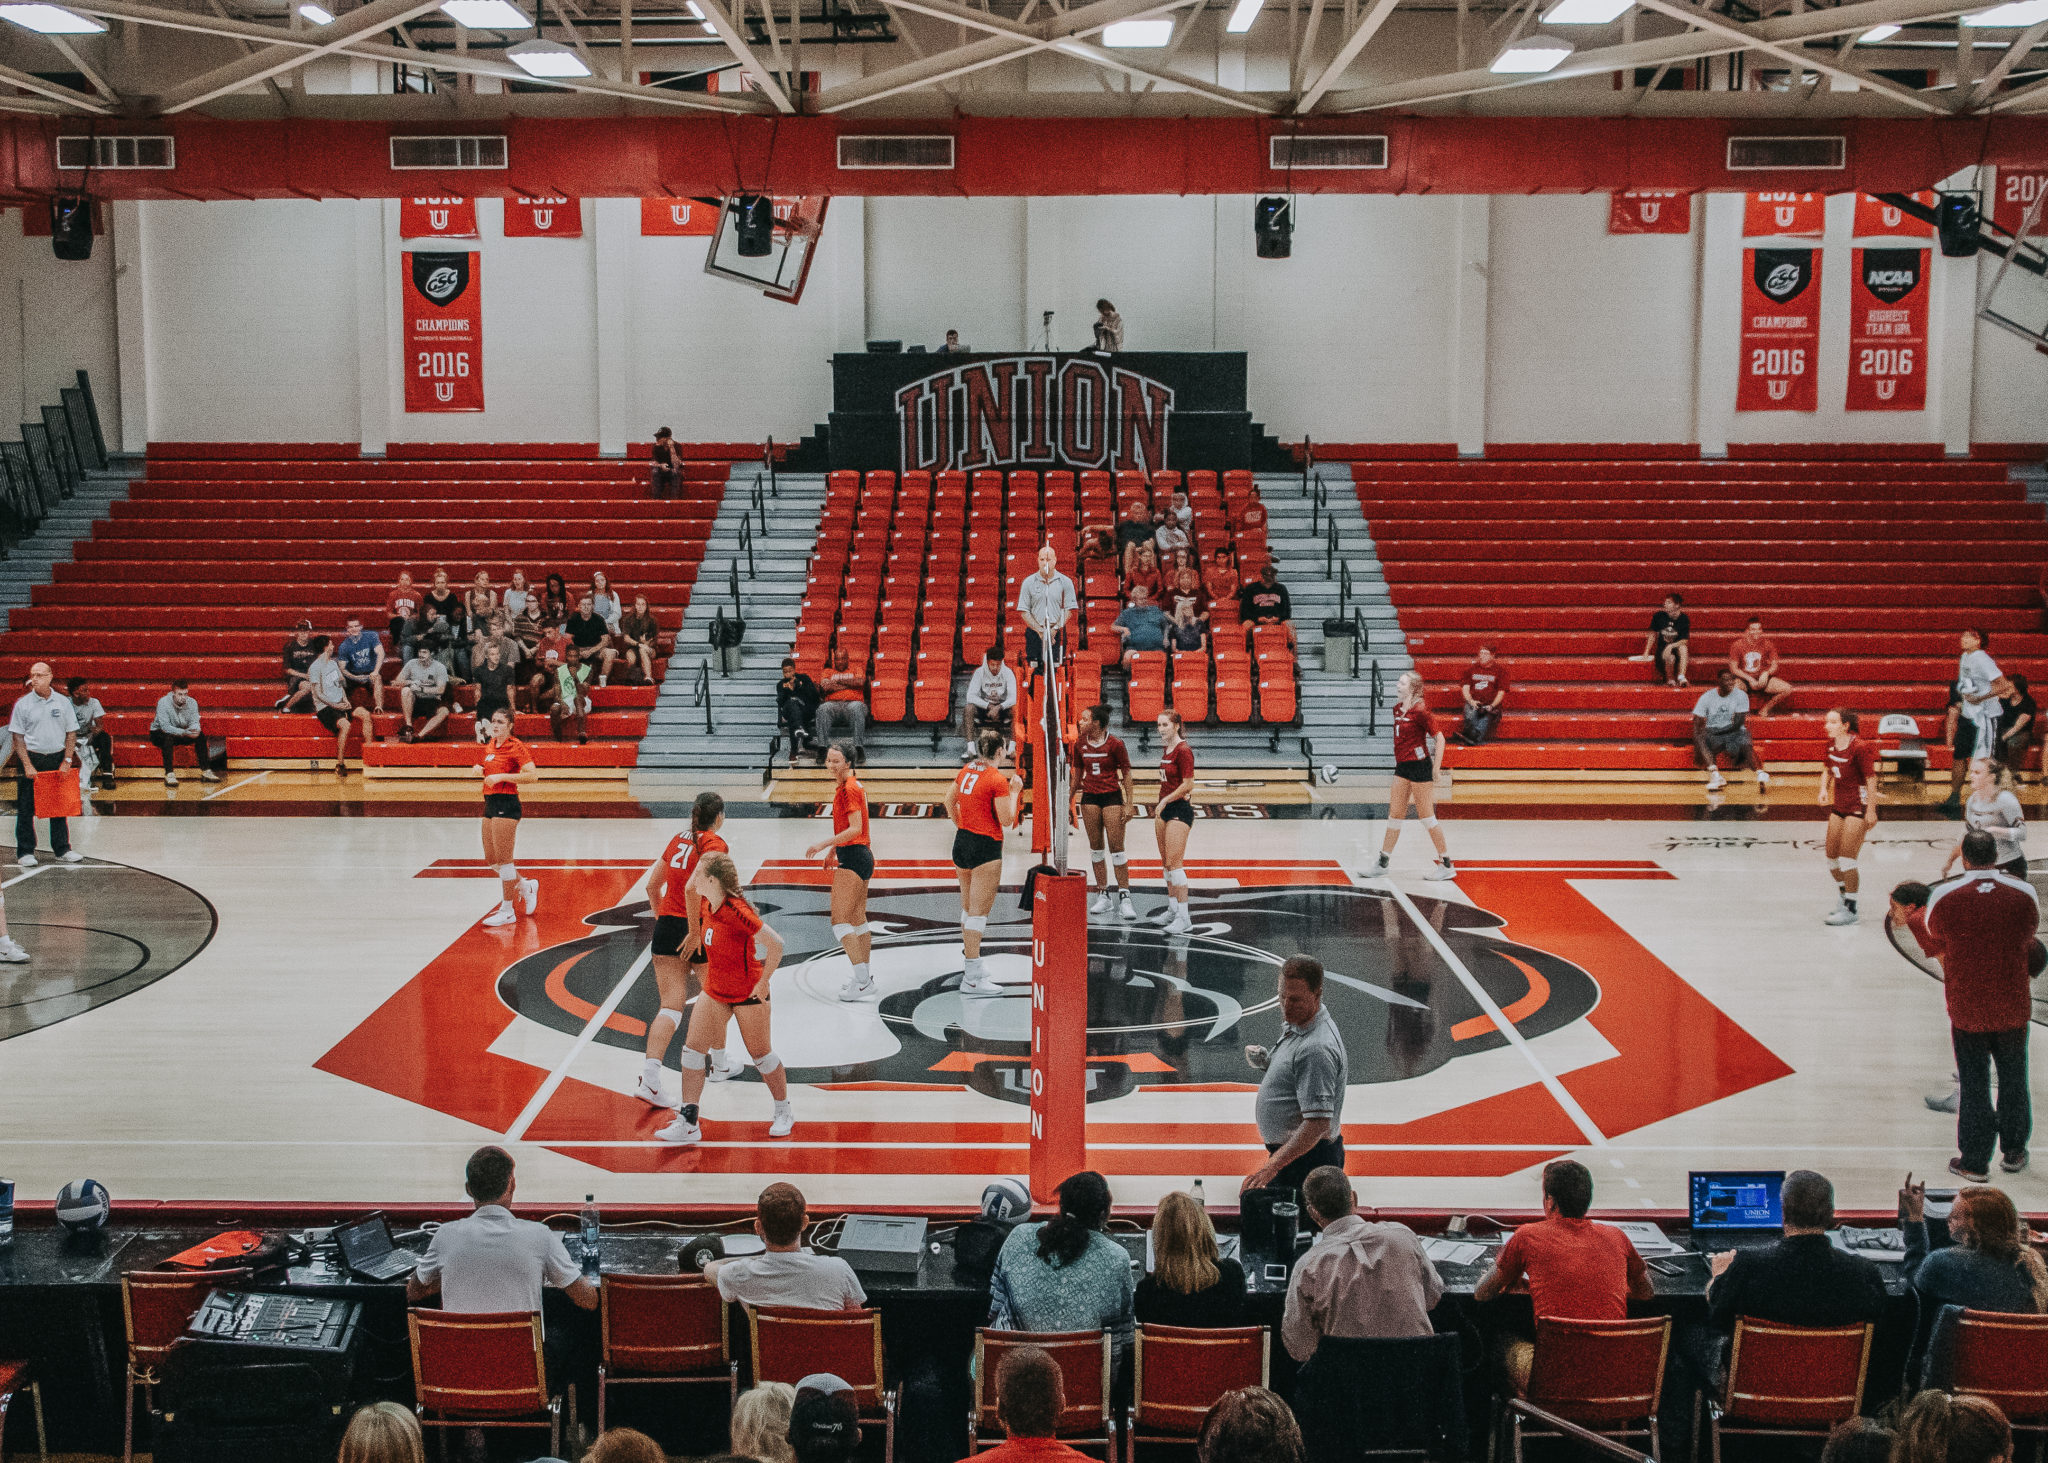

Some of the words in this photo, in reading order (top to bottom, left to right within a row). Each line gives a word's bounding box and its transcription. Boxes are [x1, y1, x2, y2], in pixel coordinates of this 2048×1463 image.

[429, 209, 449, 230] U
[533, 209, 554, 230] U
[670, 205, 692, 225] U
[1640, 202, 1661, 223] U
[1775, 206, 1795, 227] U
[1881, 206, 1902, 227] U
[1867, 270, 1914, 286] NCAA
[416, 319, 470, 331] CHAMPIONS
[1752, 316, 1808, 329] CHAMPIONS
[1868, 310, 1911, 323] HIGHEST
[1865, 323, 1893, 336] TEAM
[418, 352, 470, 377] 2016
[1751, 349, 1806, 375] 2016
[1860, 349, 1914, 375] 2016
[434, 382, 455, 402] U
[1767, 379, 1789, 400] U
[1876, 379, 1897, 400] U
[895, 356, 1175, 485] UNION
[1091, 762, 1101, 776] 5
[959, 772, 980, 795] 13
[669, 842, 694, 870] 21
[704, 927, 714, 946] 8
[1031, 938, 1046, 1140] UNION
